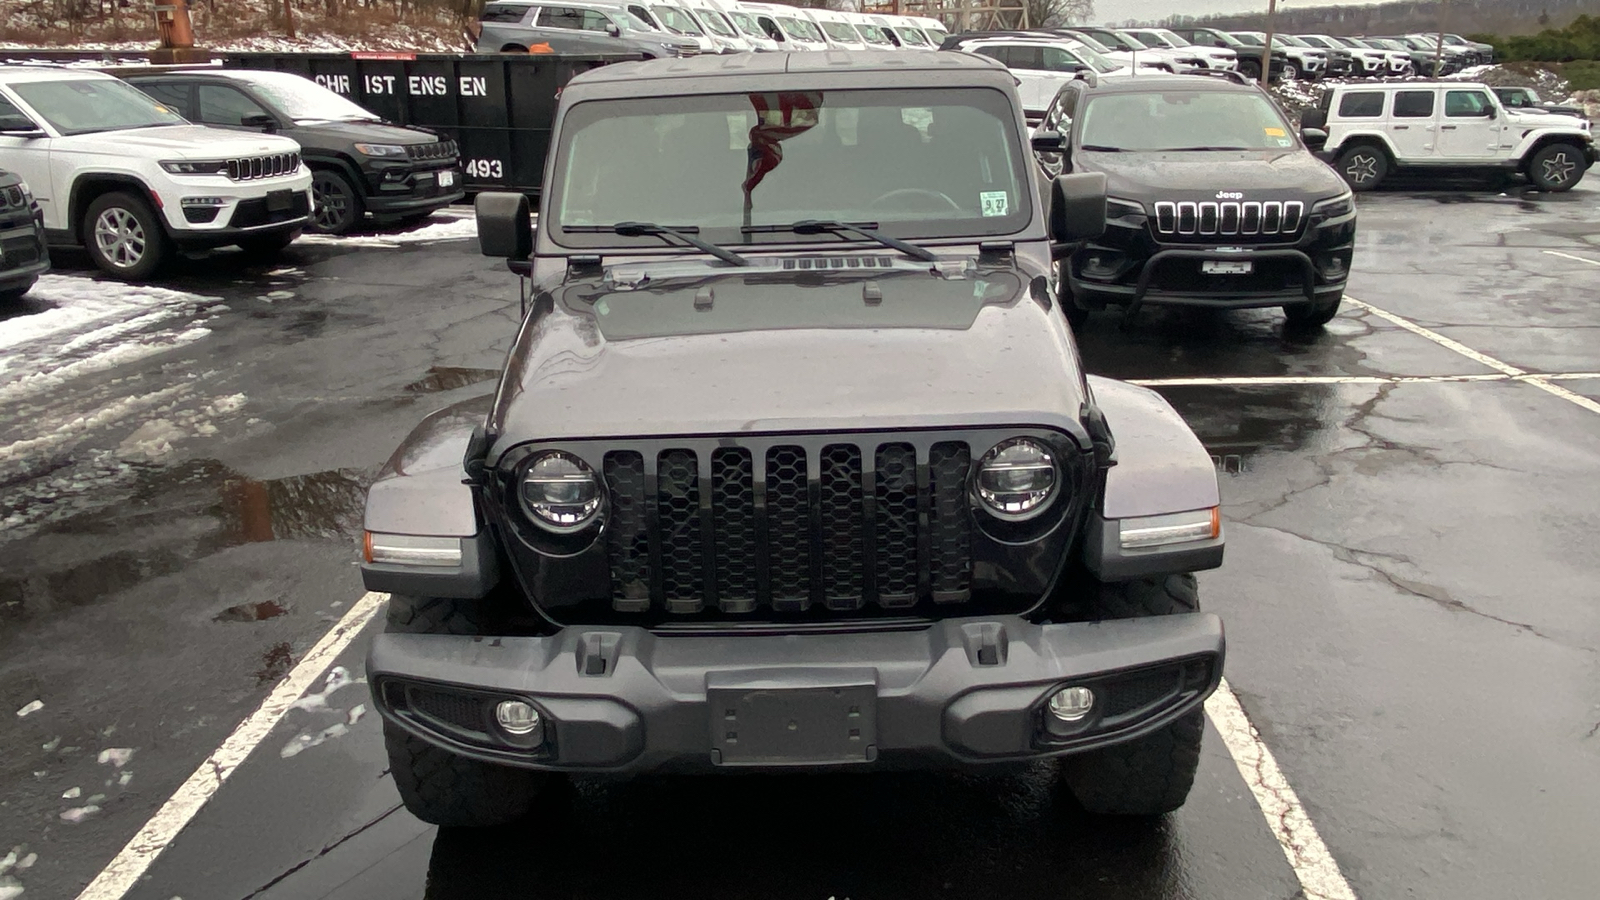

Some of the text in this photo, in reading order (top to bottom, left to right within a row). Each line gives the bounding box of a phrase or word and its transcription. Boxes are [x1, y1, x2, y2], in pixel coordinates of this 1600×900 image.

[364, 75, 396, 95] IST
[408, 76, 447, 95] ENS
[460, 76, 487, 96] EN
[1215, 190, 1243, 199] Jeep
[995, 198, 1005, 209] 27
